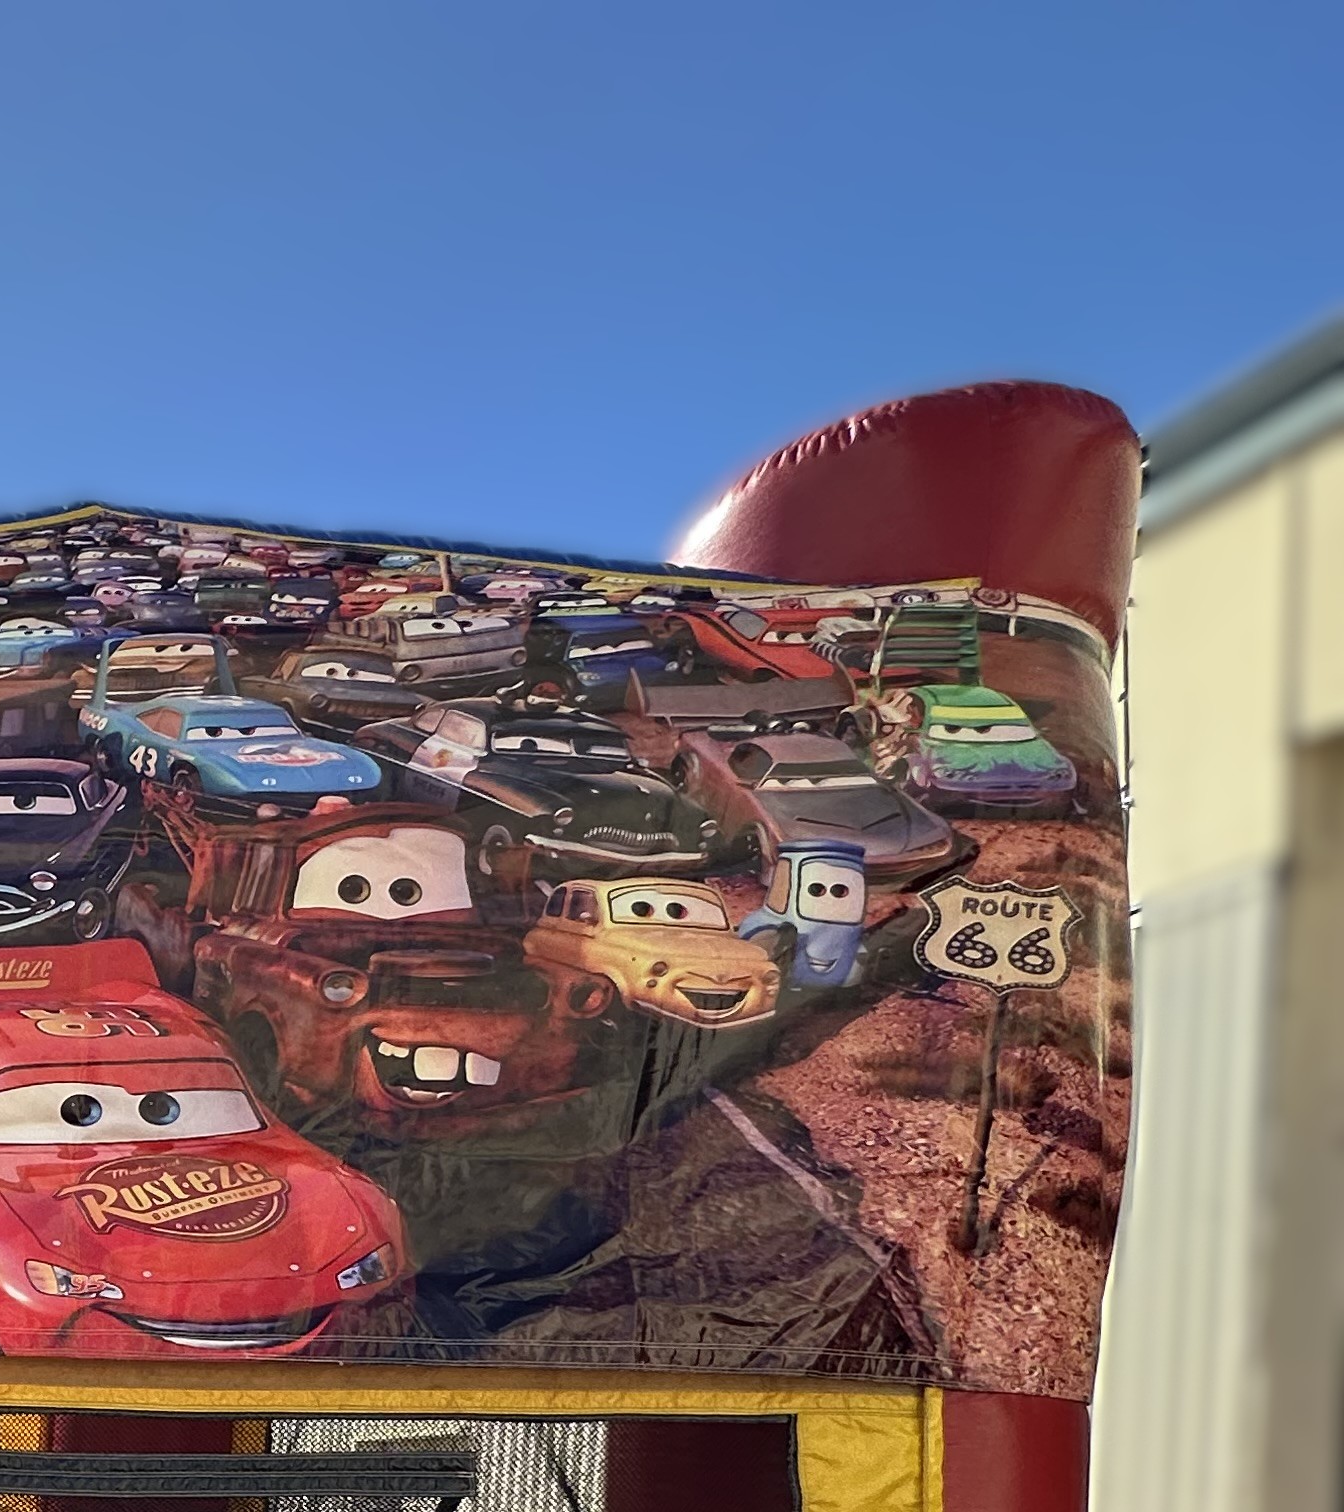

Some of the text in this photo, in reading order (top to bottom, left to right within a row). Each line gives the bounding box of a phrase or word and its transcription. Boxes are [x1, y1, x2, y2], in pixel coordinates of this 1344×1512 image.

[129, 744, 158, 778] 43
[962, 896, 1054, 922] ROUTE
[945, 922, 1056, 975] 66
[70, 1274, 108, 1294] 95
